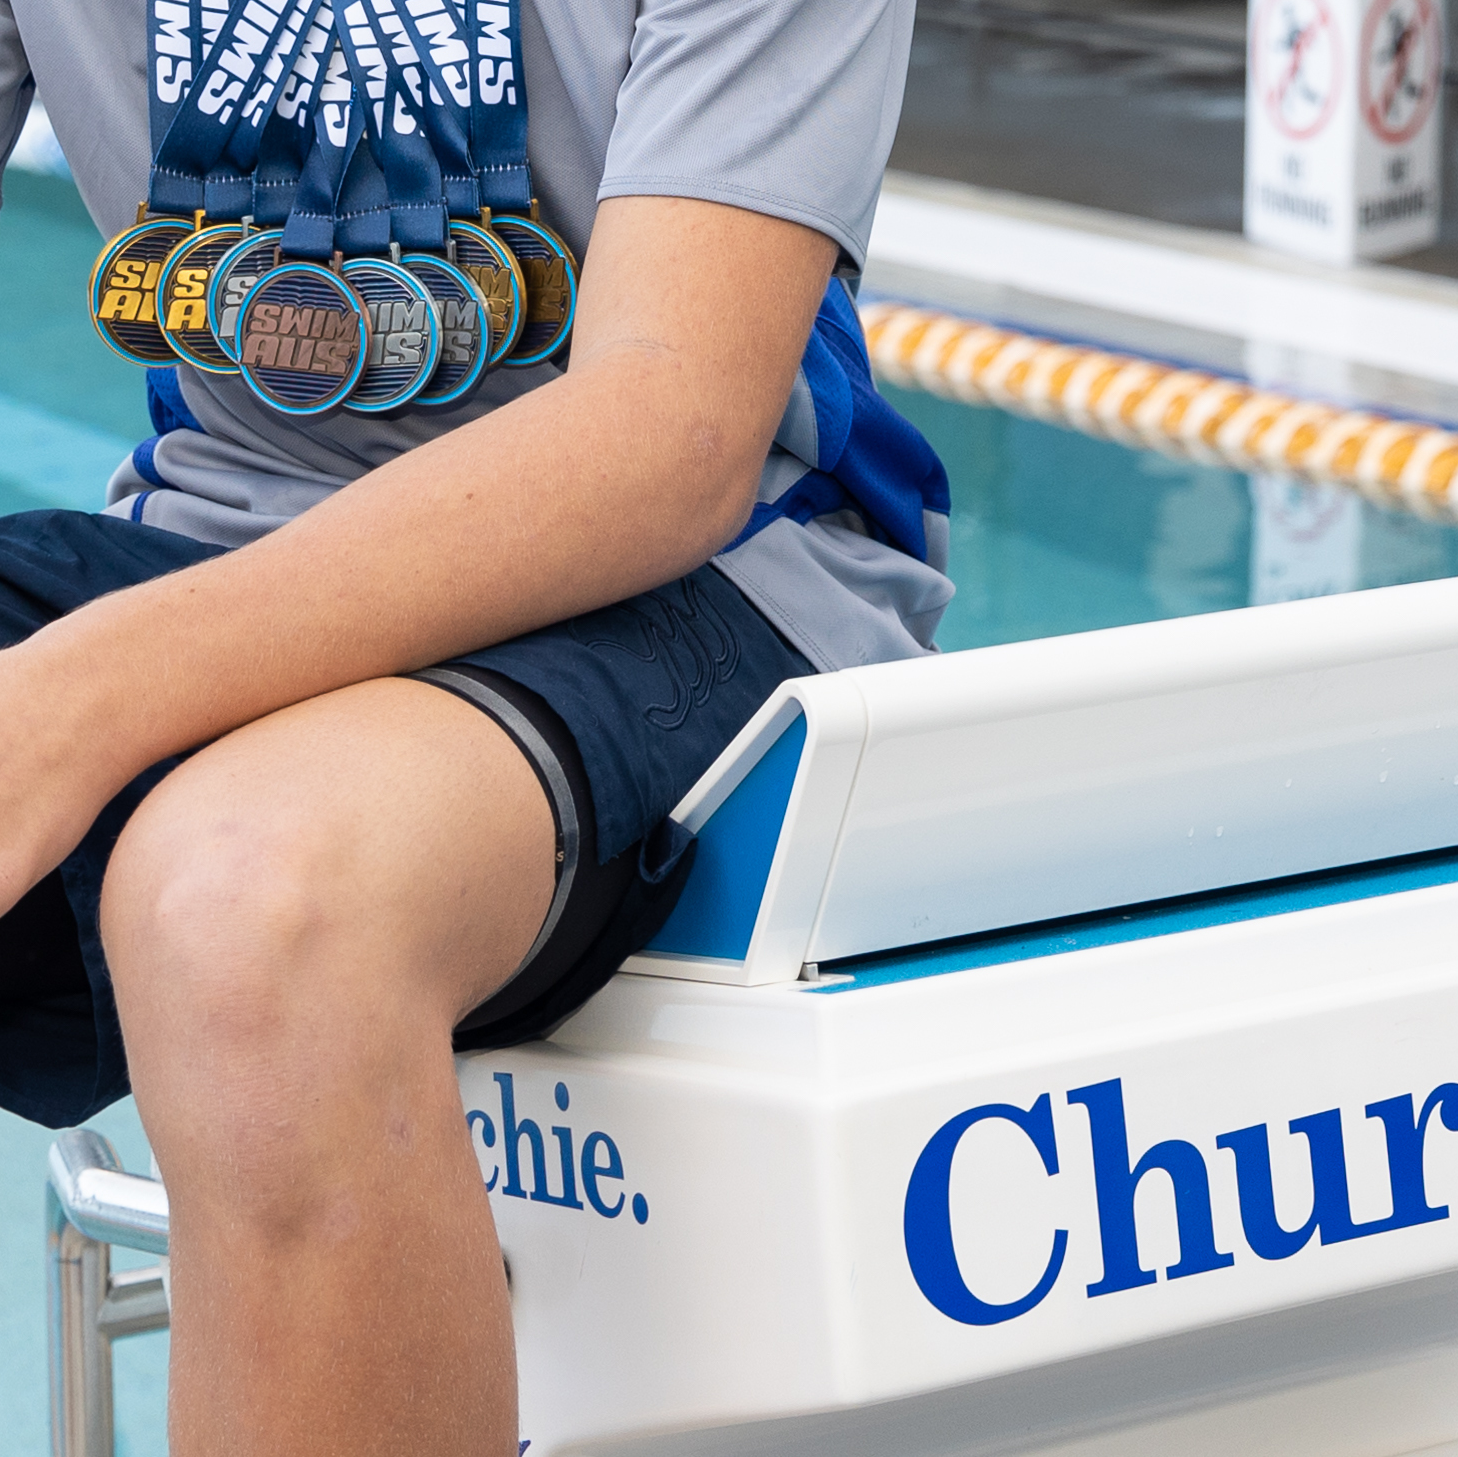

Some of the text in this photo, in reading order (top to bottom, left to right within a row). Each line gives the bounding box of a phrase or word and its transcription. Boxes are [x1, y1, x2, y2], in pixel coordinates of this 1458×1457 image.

[250, 304, 360, 342] SWIM
[242, 334, 351, 373] AUS
[466, 1072, 649, 1225] chie.
